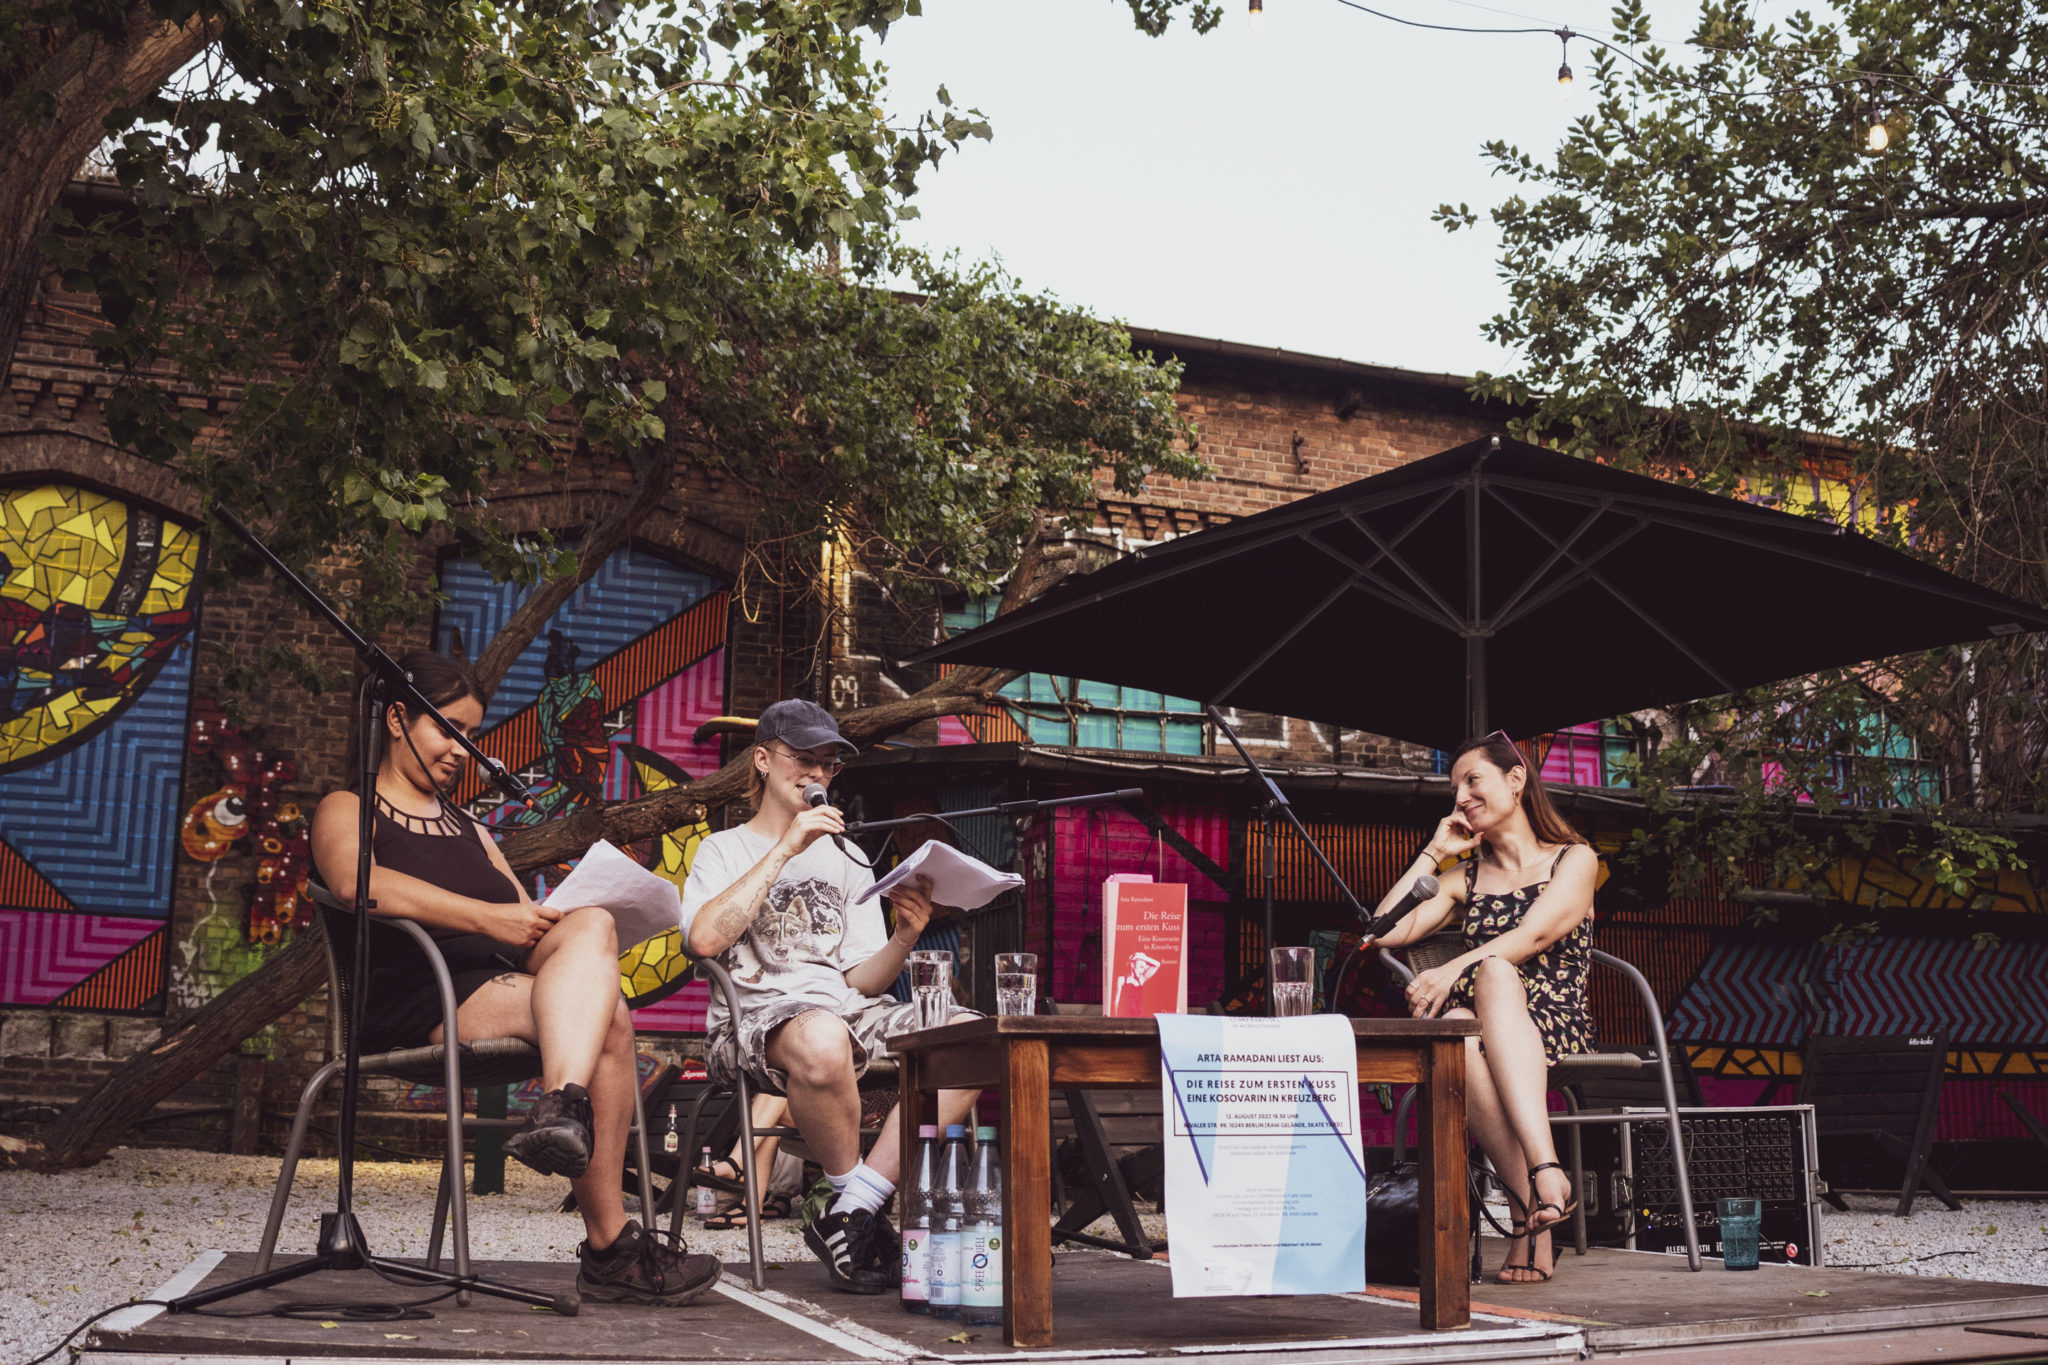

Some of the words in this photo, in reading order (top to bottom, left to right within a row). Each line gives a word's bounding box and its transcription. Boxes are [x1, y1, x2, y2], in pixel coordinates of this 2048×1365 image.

[1143, 911, 1158, 920] Die
[1160, 911, 1182, 920] Reise
[1136, 923, 1159, 931] ersten
[1161, 922, 1180, 931] Kuss
[1197, 1054, 1222, 1063] ARTA
[1223, 1054, 1275, 1063] RAMADANI
[1278, 1054, 1300, 1063] LIEST
[1302, 1054, 1325, 1063] AUS:
[1186, 1080, 1203, 1089] DIE
[1207, 1080, 1235, 1089] REISE
[1239, 1080, 1264, 1089] ZUM
[1267, 1080, 1305, 1089] ERSTEN
[1308, 1080, 1336, 1089] KUSS
[1187, 1094, 1207, 1103] EINE
[1209, 1094, 1267, 1103] KOSOVARIN
[1269, 1094, 1279, 1103] IN
[1281, 1094, 1337, 1103] KREUZBERG
